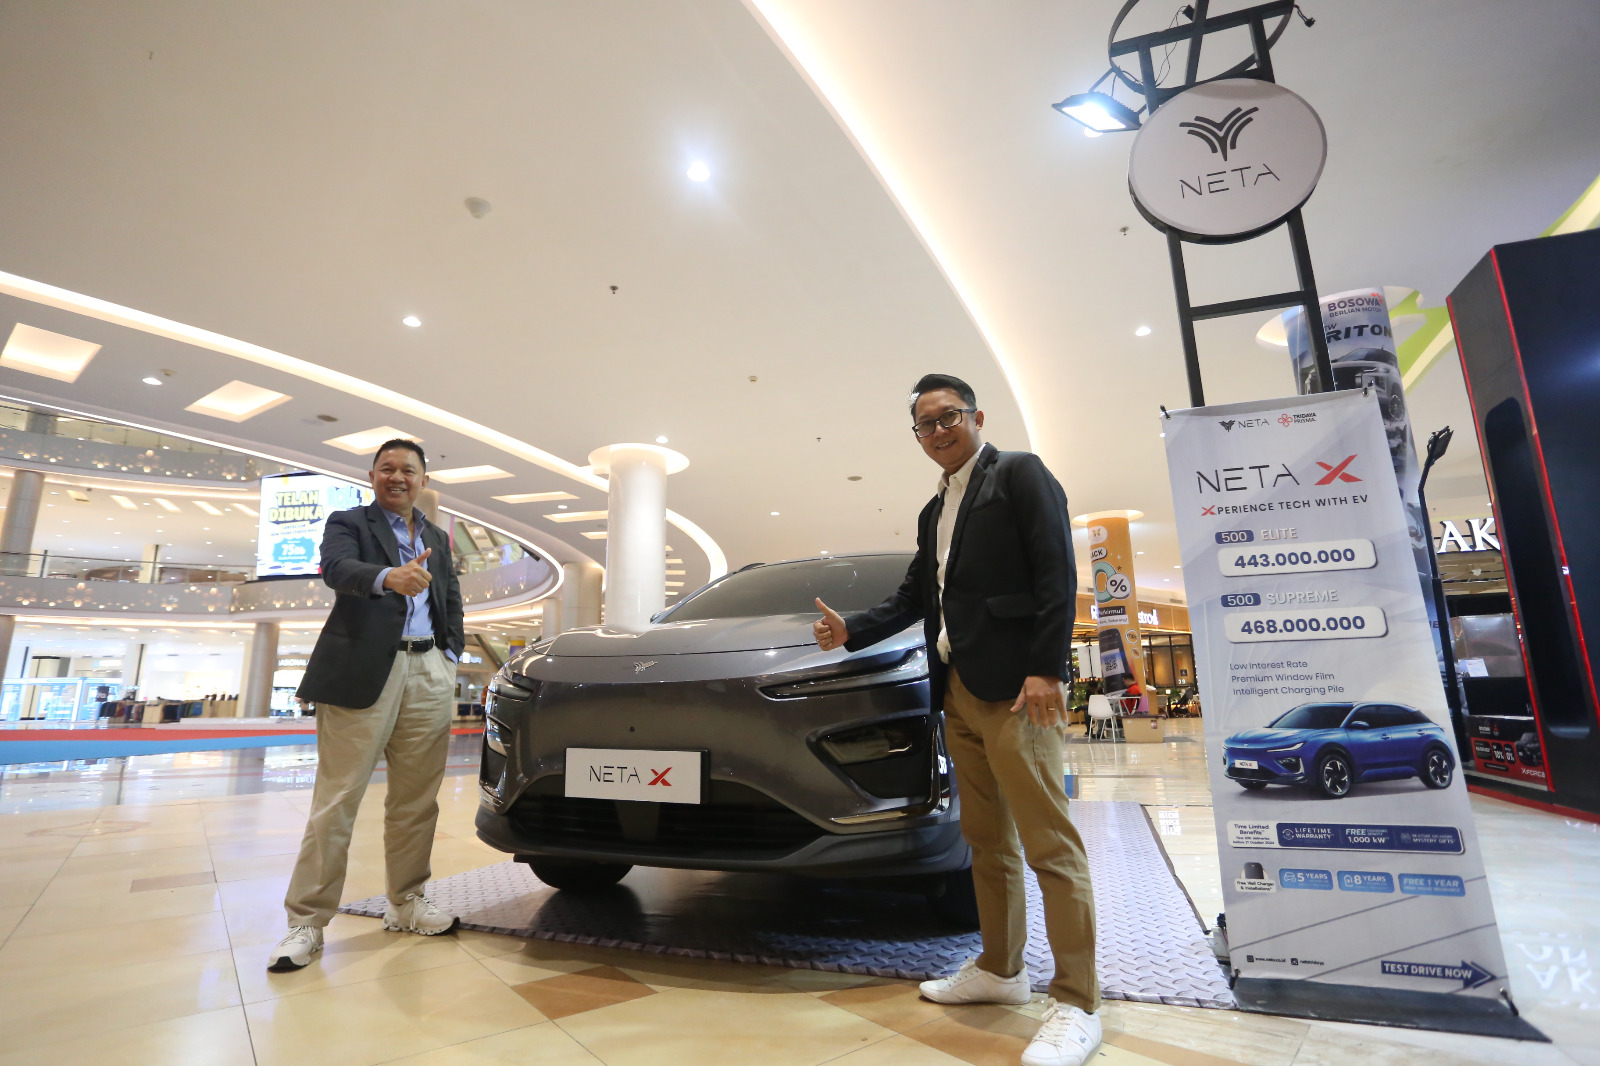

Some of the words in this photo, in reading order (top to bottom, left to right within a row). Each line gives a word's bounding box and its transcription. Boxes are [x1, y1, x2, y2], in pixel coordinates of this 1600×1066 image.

[1179, 163, 1280, 199] NETA
[1328, 297, 1381, 312] BOSOWA
[1329, 308, 1361, 318] BERLIAN
[1326, 324, 1392, 343] RITON
[1238, 418, 1270, 429] NETA
[1196, 463, 1300, 494] NETA
[275, 490, 319, 507] TELAH
[1278, 499, 1311, 511] TECH
[1315, 496, 1348, 508] WITH
[1352, 494, 1368, 504] EV
[269, 505, 324, 523] DIBUKA
[1221, 531, 1247, 542] 500
[1261, 528, 1298, 541] ELITE
[1234, 548, 1355, 569] 443.000.000
[1227, 594, 1254, 606] 500
[1266, 589, 1339, 605] SUPREME
[1241, 615, 1366, 635] 468.000.000
[1249, 661, 1284, 670] Interest
[1286, 660, 1308, 669] Rate
[1231, 674, 1274, 683] Premium
[1275, 673, 1314, 682] Window
[1315, 672, 1335, 681] Film
[1233, 687, 1279, 697] Intelligent
[1281, 686, 1327, 696] Charging
[1328, 685, 1345, 693] Pile
[589, 765, 641, 784] NETA
[1345, 828, 1367, 836] FREE
[1297, 873, 1305, 882] 5
[1354, 875, 1362, 885] 8
[1404, 877, 1425, 886] FREE
[1434, 879, 1459, 887] YEAR
[1384, 963, 1410, 974] TEST
[1412, 964, 1443, 976] DRIVE
[1444, 966, 1473, 979] NOW
